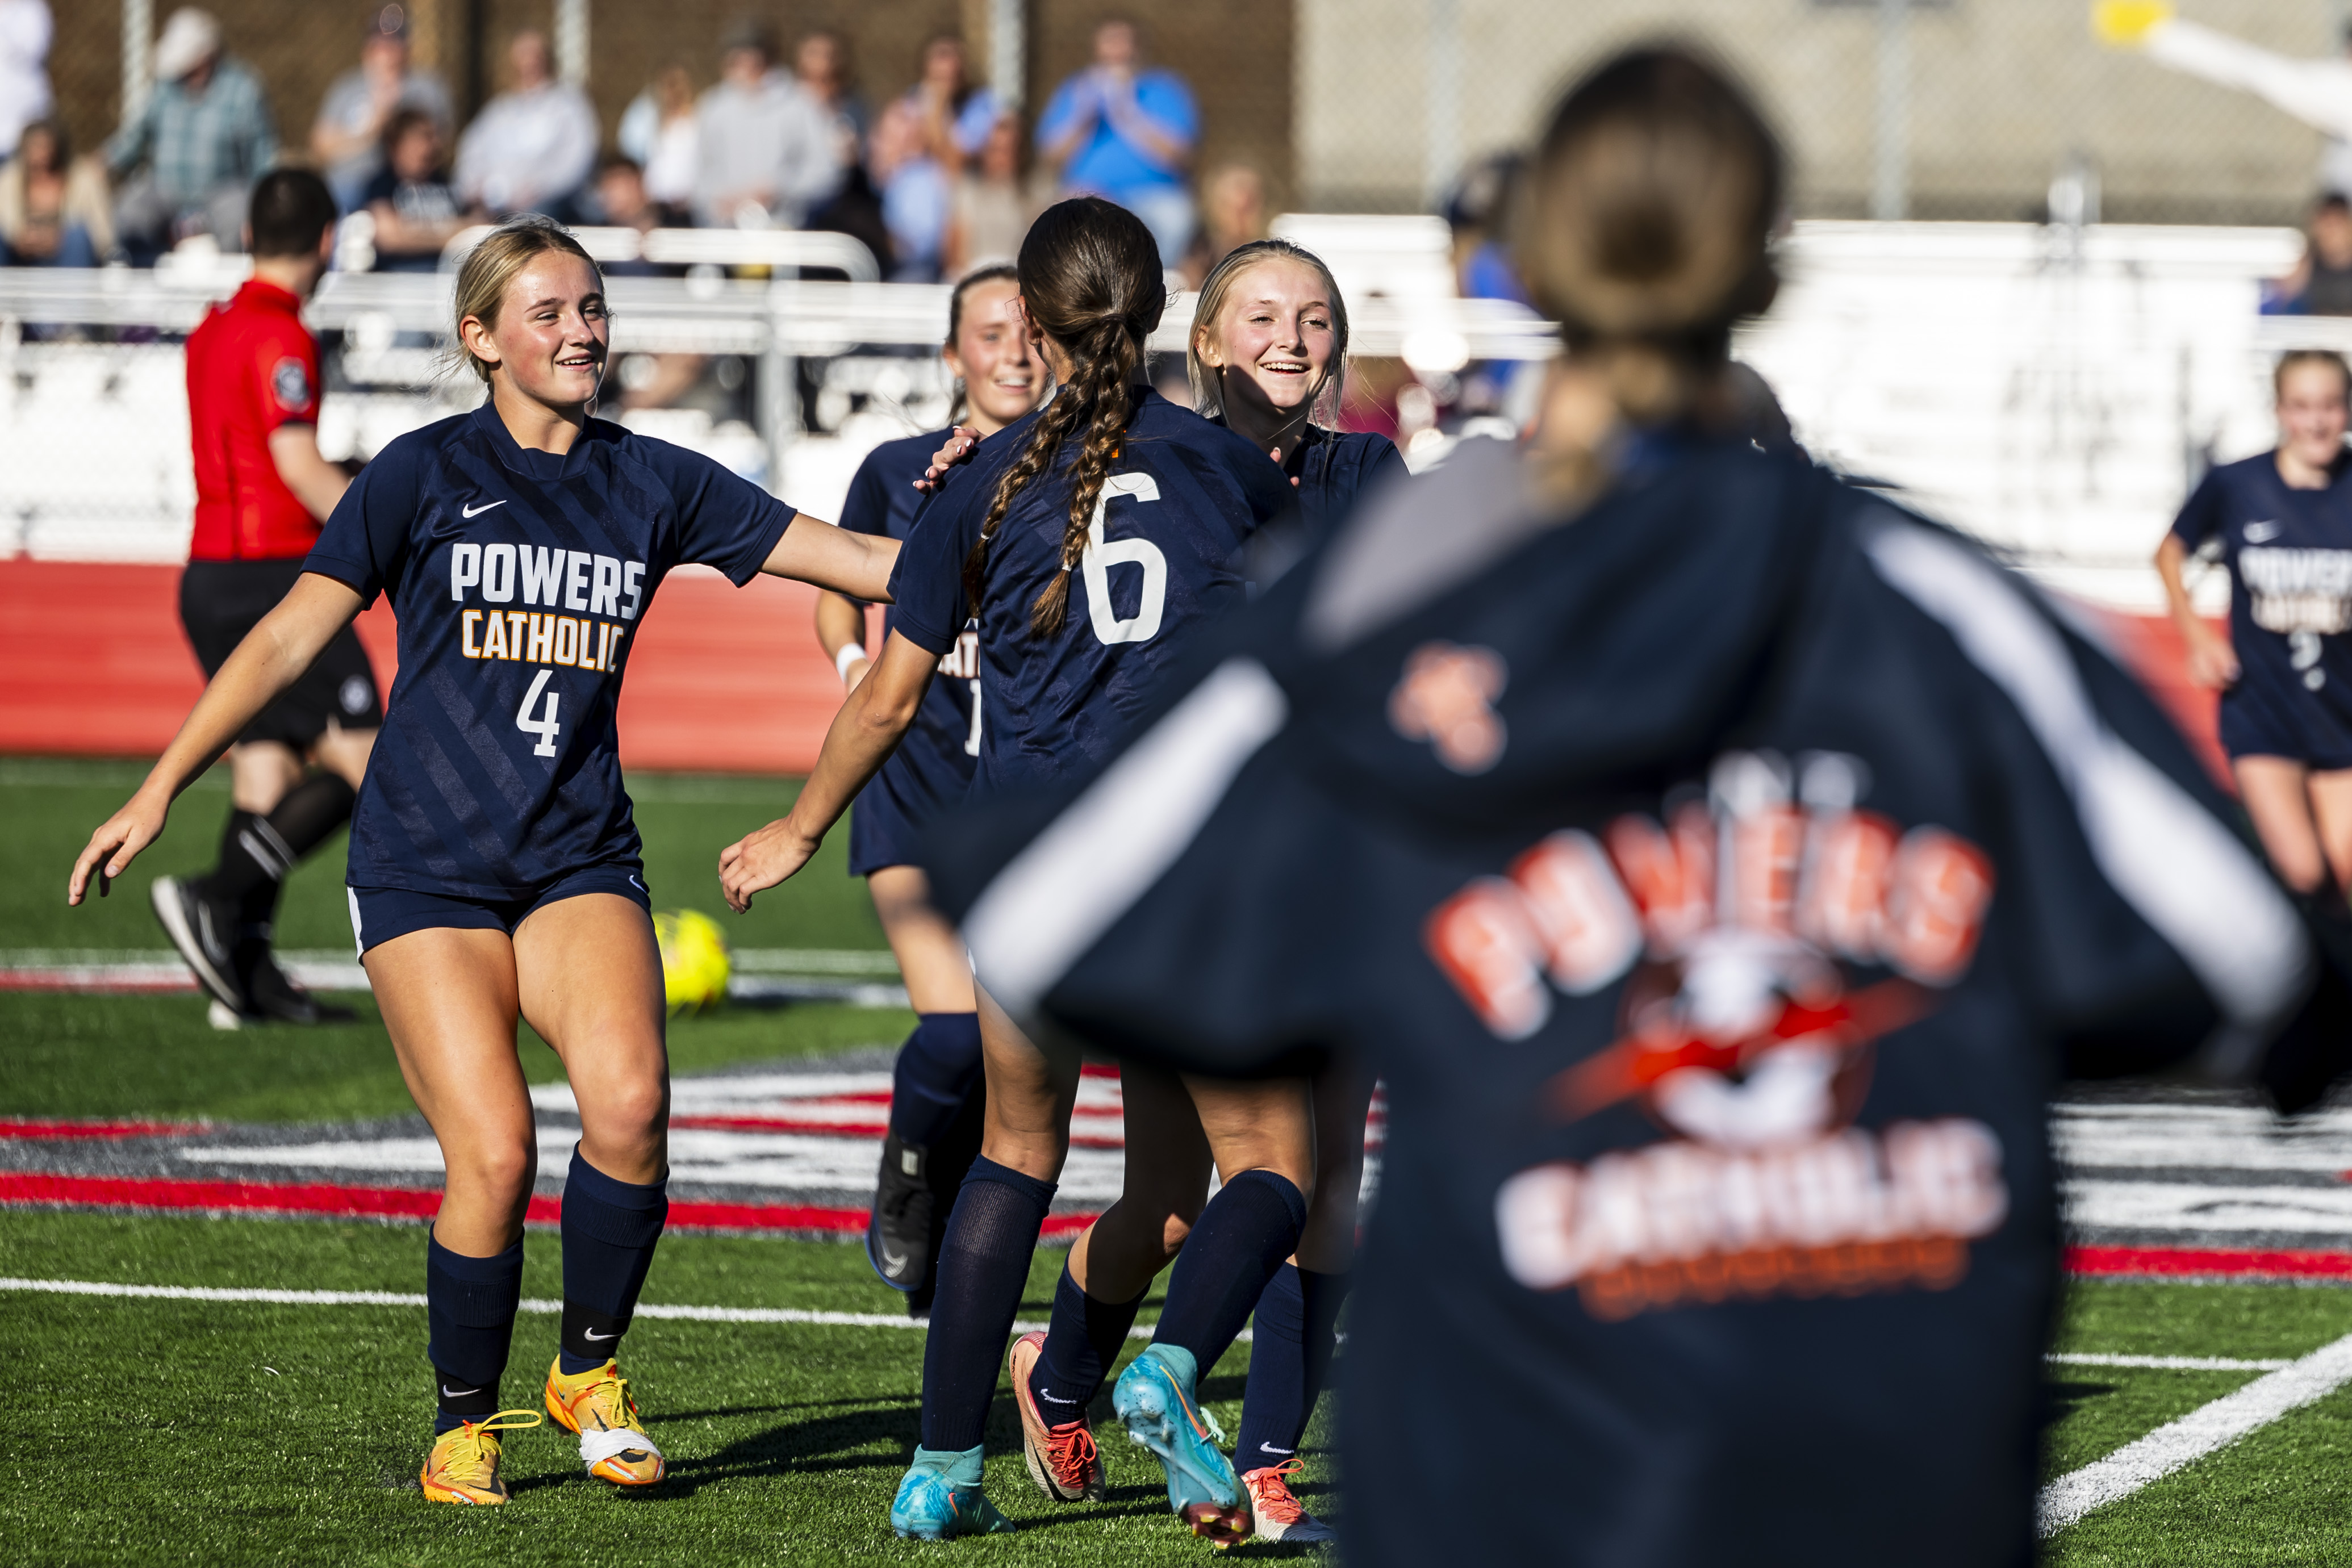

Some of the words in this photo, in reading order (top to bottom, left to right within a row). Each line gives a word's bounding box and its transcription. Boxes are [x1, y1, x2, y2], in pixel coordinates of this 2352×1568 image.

[452, 543, 646, 620] POWERS
[1081, 472, 1167, 645] 6
[462, 609, 623, 674] CATHOLIC
[516, 670, 560, 757] 4
